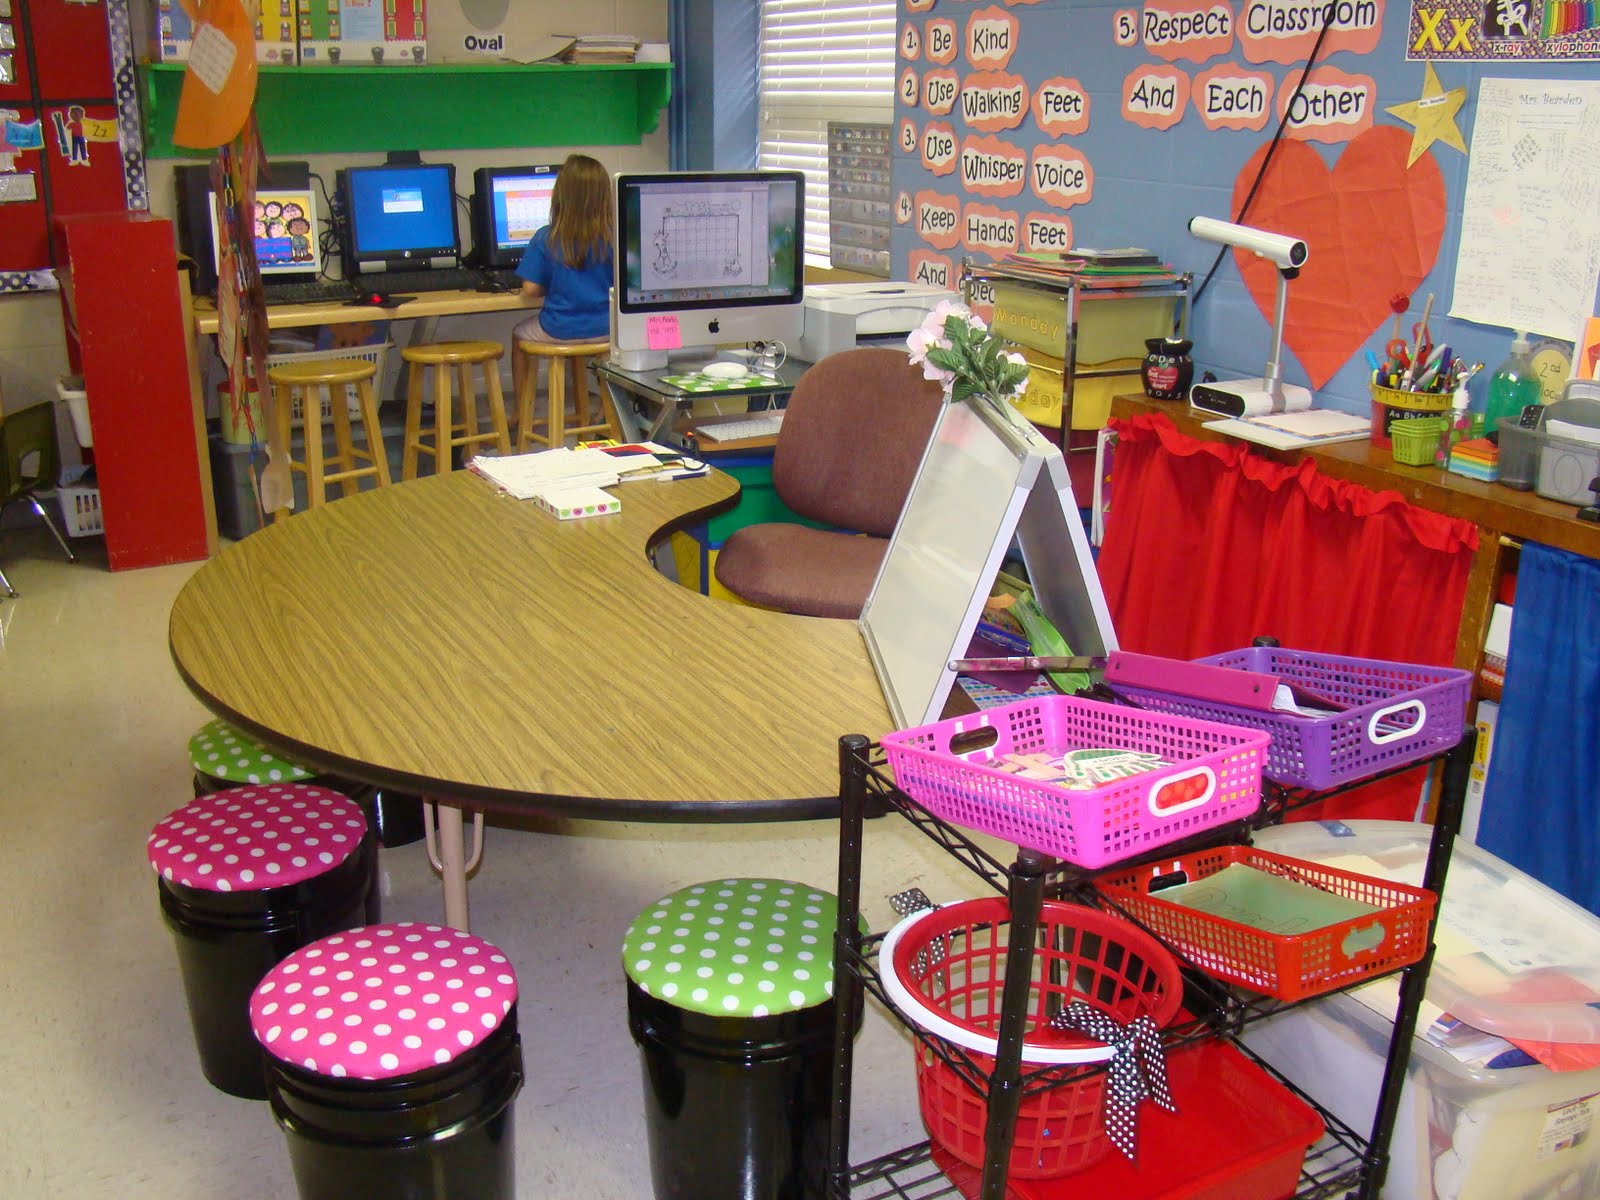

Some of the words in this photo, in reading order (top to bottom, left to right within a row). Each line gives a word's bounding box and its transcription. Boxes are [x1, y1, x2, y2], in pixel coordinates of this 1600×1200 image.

[1119, 16, 1135, 39] 5.
[1144, 12, 1229, 42] Respect
[1247, 1, 1376, 34] Classroom
[464, 35, 503, 51] Oval
[906, 31, 917, 49] 1.
[932, 28, 952, 52] Be
[973, 27, 1009, 54] Kind
[1494, 42, 1521, 54] x-ray
[1547, 41, 1600, 54] xylophon
[905, 79, 915, 97] 2.
[928, 81, 954, 105] Use
[962, 90, 1022, 117] Walking
[1043, 91, 1082, 116] Feet
[1131, 79, 1175, 110] And
[1207, 83, 1264, 113] Each
[1288, 89, 1366, 124] Other
[1542, 92, 1582, 105] Bearden
[92, 124, 107, 138] Zz
[904, 128, 915, 146] 3.
[926, 136, 953, 160] Use
[963, 155, 1023, 180] Whisper
[1035, 163, 1084, 188] Voice
[900, 198, 912, 216] 4.
[921, 207, 956, 231] Keep
[967, 218, 1015, 243] Hands
[1029, 222, 1066, 246] Feet
[916, 261, 947, 286] And
[996, 307, 1059, 341] Monday
